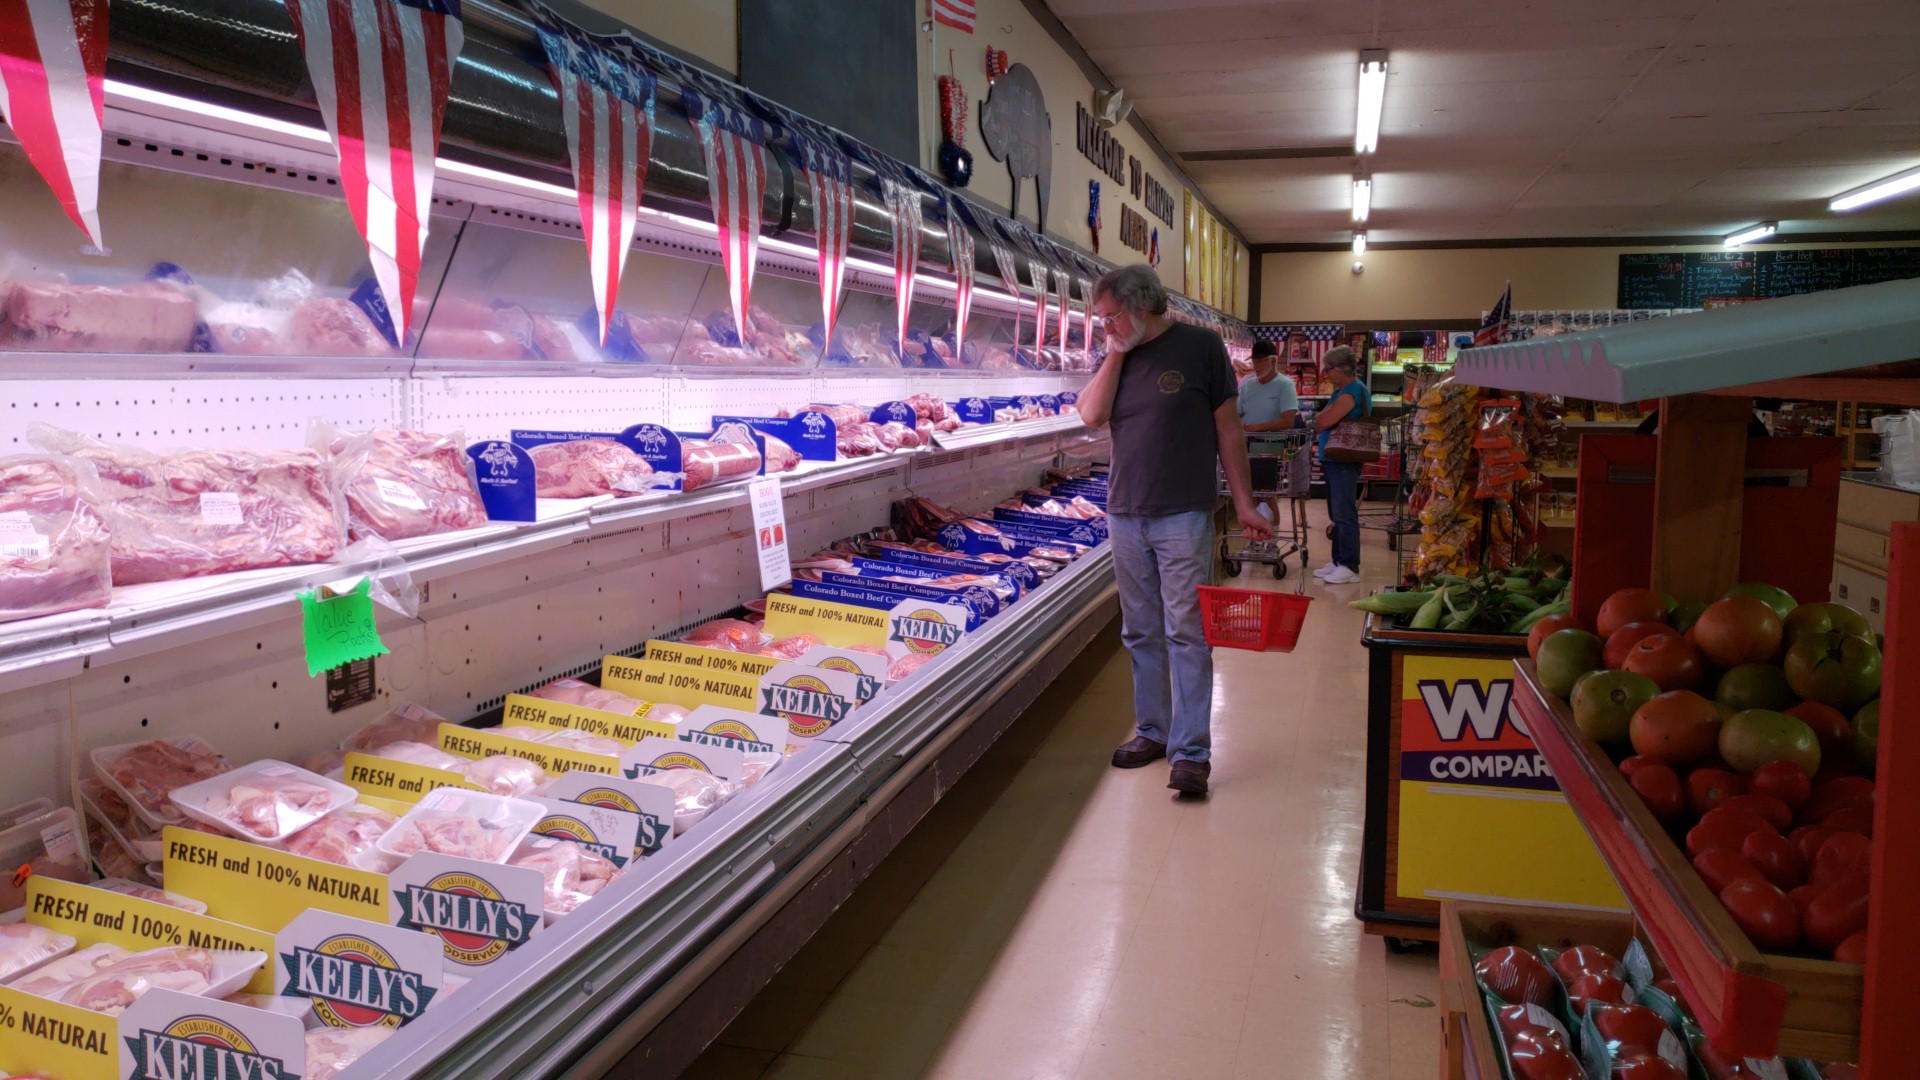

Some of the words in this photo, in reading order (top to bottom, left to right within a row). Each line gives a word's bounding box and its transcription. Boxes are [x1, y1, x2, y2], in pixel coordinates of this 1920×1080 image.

[1076, 100, 1125, 187] WELCOME
[1129, 154, 1142, 201] TO
[1145, 172, 1175, 230] HARVEST
[1120, 202, 1149, 256] MEATS
[514, 432, 546, 441] Colorado
[546, 433, 569, 441] Boxed
[570, 433, 584, 441] Beef
[585, 435, 616, 443] Company
[862, 560, 894, 573] Colorado
[894, 566, 922, 579] Boxed
[922, 570, 935, 579] Beef
[890, 550, 919, 561] Colorado
[920, 554, 942, 565] Boxed
[941, 556, 958, 567] Beef
[958, 559, 990, 571] Company
[804, 583, 840, 598] Colorado
[840, 589, 870, 602] Boxed
[870, 593, 886, 603] Beef
[832, 574, 866, 587] Colorado
[866, 579, 890, 590] Boxed
[891, 581, 909, 593] Beef
[908, 585, 946, 599] Company
[769, 601, 797, 615] FRESH
[798, 606, 815, 617] and
[816, 607, 843, 622] 100%
[845, 613, 885, 629] NATURAL
[897, 616, 957, 646] KELLY'S
[649, 648, 682, 664] FRESH
[684, 655, 701, 667] and
[706, 656, 738, 672] 100%
[740, 662, 776, 677] NATU
[608, 665, 642, 682] FRESH
[644, 672, 664, 685] and
[668, 673, 701, 691] 100%
[704, 680, 754, 700] NATURAL
[769, 685, 843, 721] KELLY'S
[508, 704, 547, 723] FRESH
[549, 713, 571, 729] and
[574, 716, 609, 736] 100%
[443, 734, 482, 757] FRESH
[351, 765, 395, 788] FRESH
[398, 776, 424, 793] and
[585, 790, 619, 803] ESTABLISHED
[539, 819, 576, 833] ESTABLISHED
[169, 841, 218, 868] FRESH
[222, 856, 250, 875] and
[256, 860, 302, 888] 100%
[306, 873, 381, 907] NATURAL
[437, 876, 477, 889] ESTABLISHED
[477, 883, 492, 897] 1981
[32, 892, 90, 924] FRESH
[93, 910, 126, 931] and
[131, 914, 183, 946] 100%
[409, 886, 524, 942] KELLY'S
[328, 939, 371, 954] ESTABLISHED
[370, 948, 387, 965] 1981
[443, 941, 504, 962] ODSERVICE
[297, 949, 420, 1017] KELLY'S
[22, 1010, 109, 1056] NATURAL
[177, 1020, 224, 1038] ESTABLISHED
[225, 1029, 245, 1049] 1981
